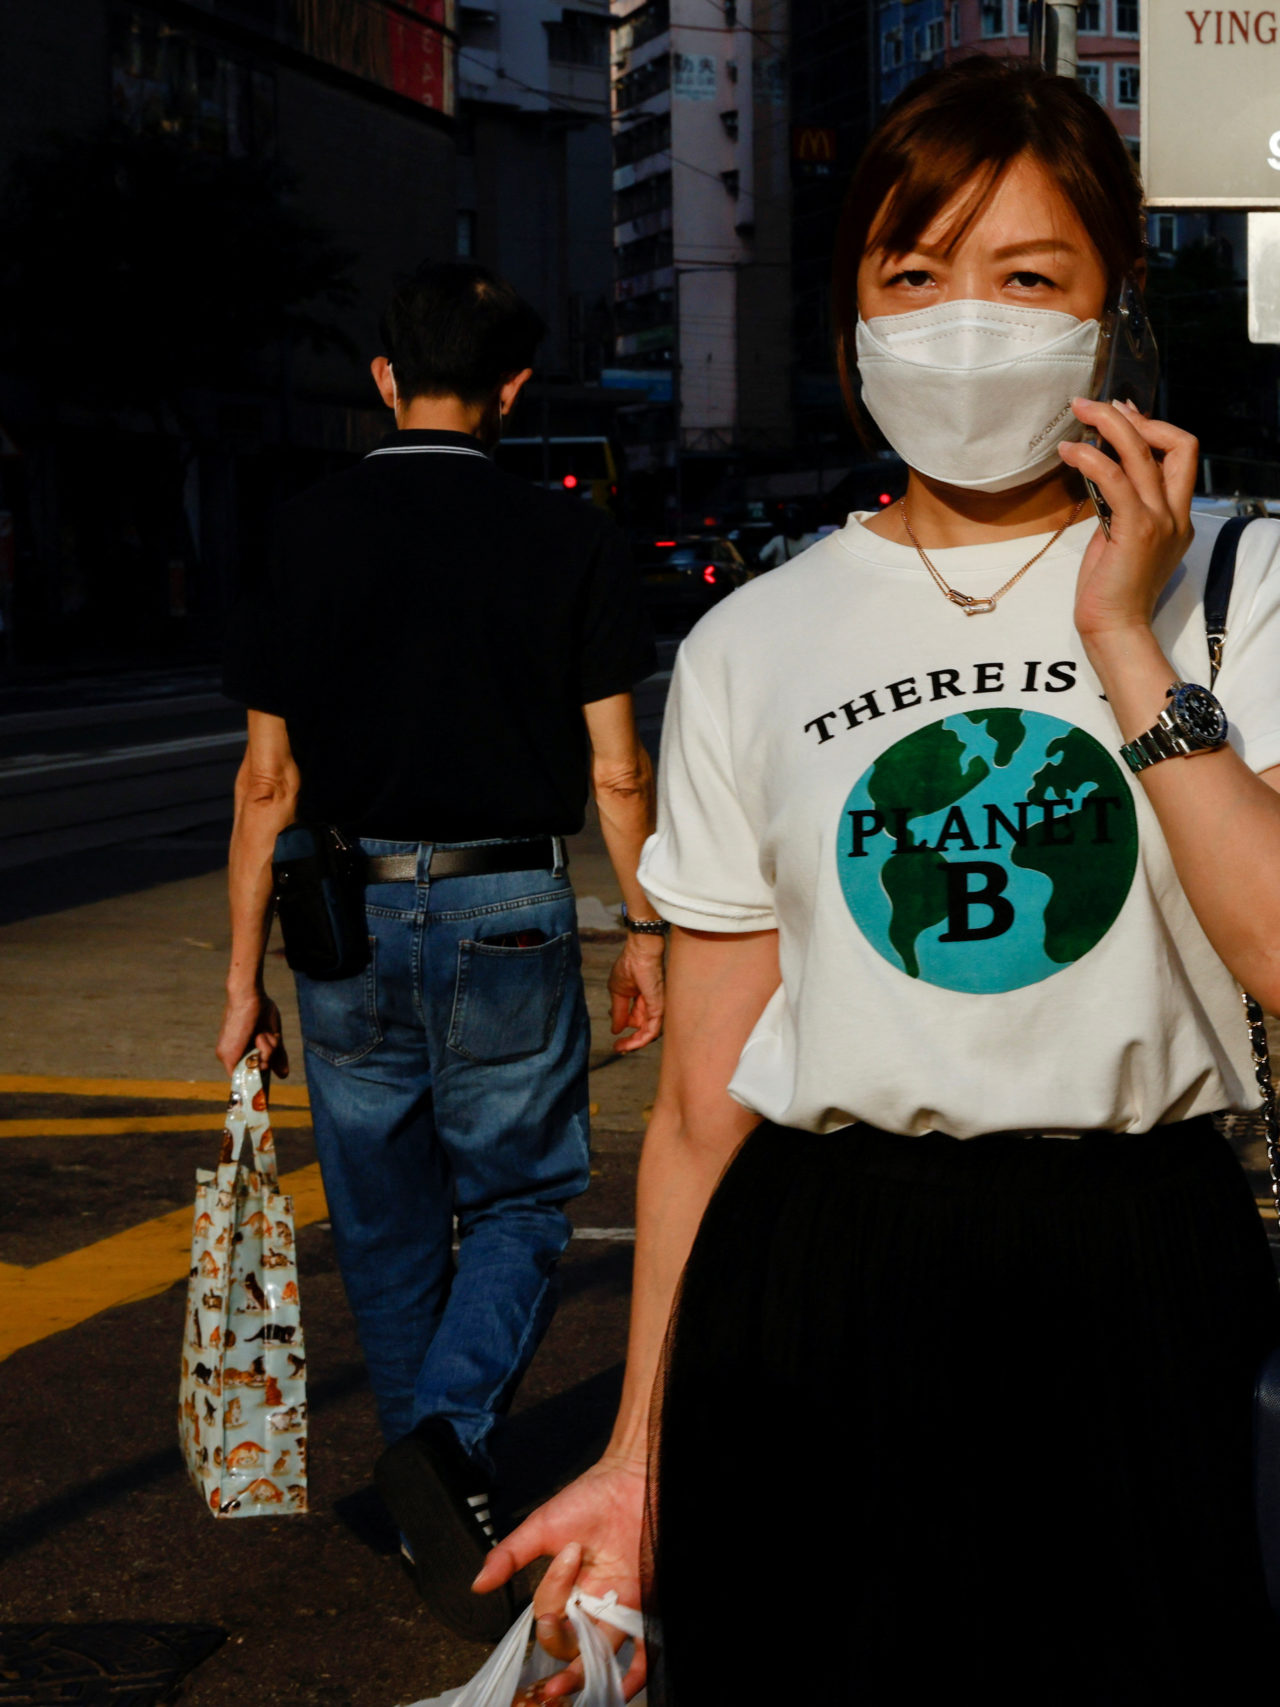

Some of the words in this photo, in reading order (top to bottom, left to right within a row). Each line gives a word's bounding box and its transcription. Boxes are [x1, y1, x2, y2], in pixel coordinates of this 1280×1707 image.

[1185, 10, 1278, 45] YING
[804, 661, 1005, 746] THERE
[1020, 660, 1077, 693] IS
[847, 797, 1124, 858] PLANET
[938, 860, 1015, 943] B
